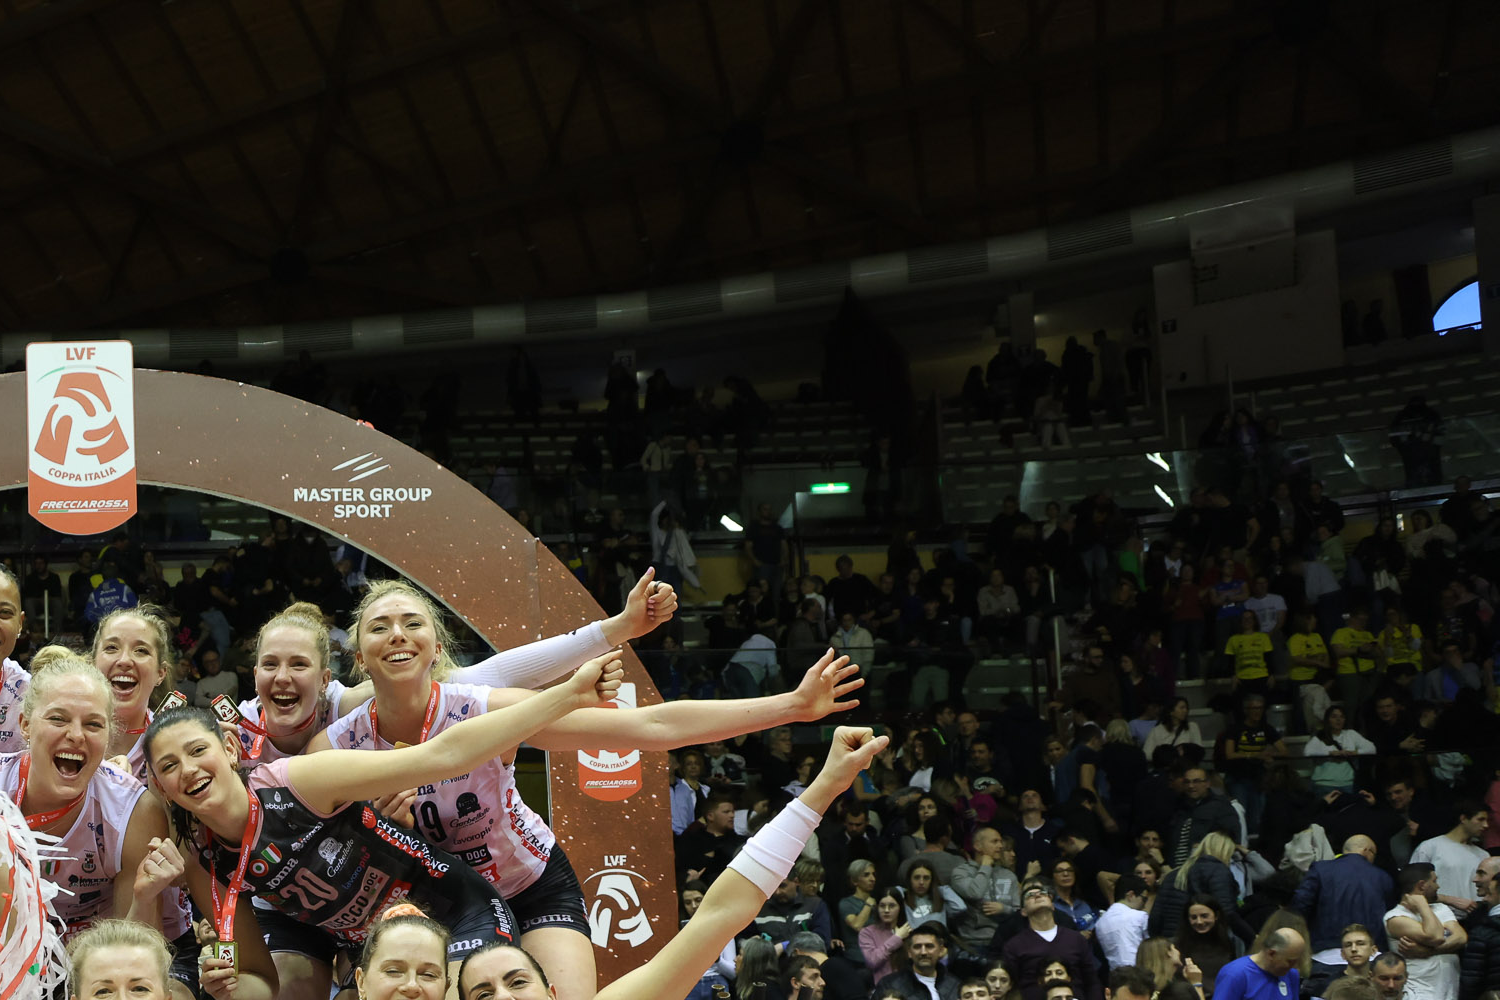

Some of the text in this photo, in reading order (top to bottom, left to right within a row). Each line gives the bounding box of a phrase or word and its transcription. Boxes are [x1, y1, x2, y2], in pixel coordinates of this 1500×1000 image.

[66, 347, 96, 361] LVF
[48, 466, 117, 481] COPPA ITALIA
[293, 487, 432, 502] MASTER GROUP
[40, 500, 129, 509] FRECCIAROSSA
[333, 504, 393, 518] SPORT
[589, 759, 630, 769] COPPA ITALIA
[466, 848, 487, 863] DOC
[603, 855, 627, 867] LVF
[266, 856, 299, 890] Joma
[280, 866, 340, 912] 20
[363, 871, 379, 892] DOC
[522, 913, 574, 930] Joma
[448, 938, 483, 953] ma
